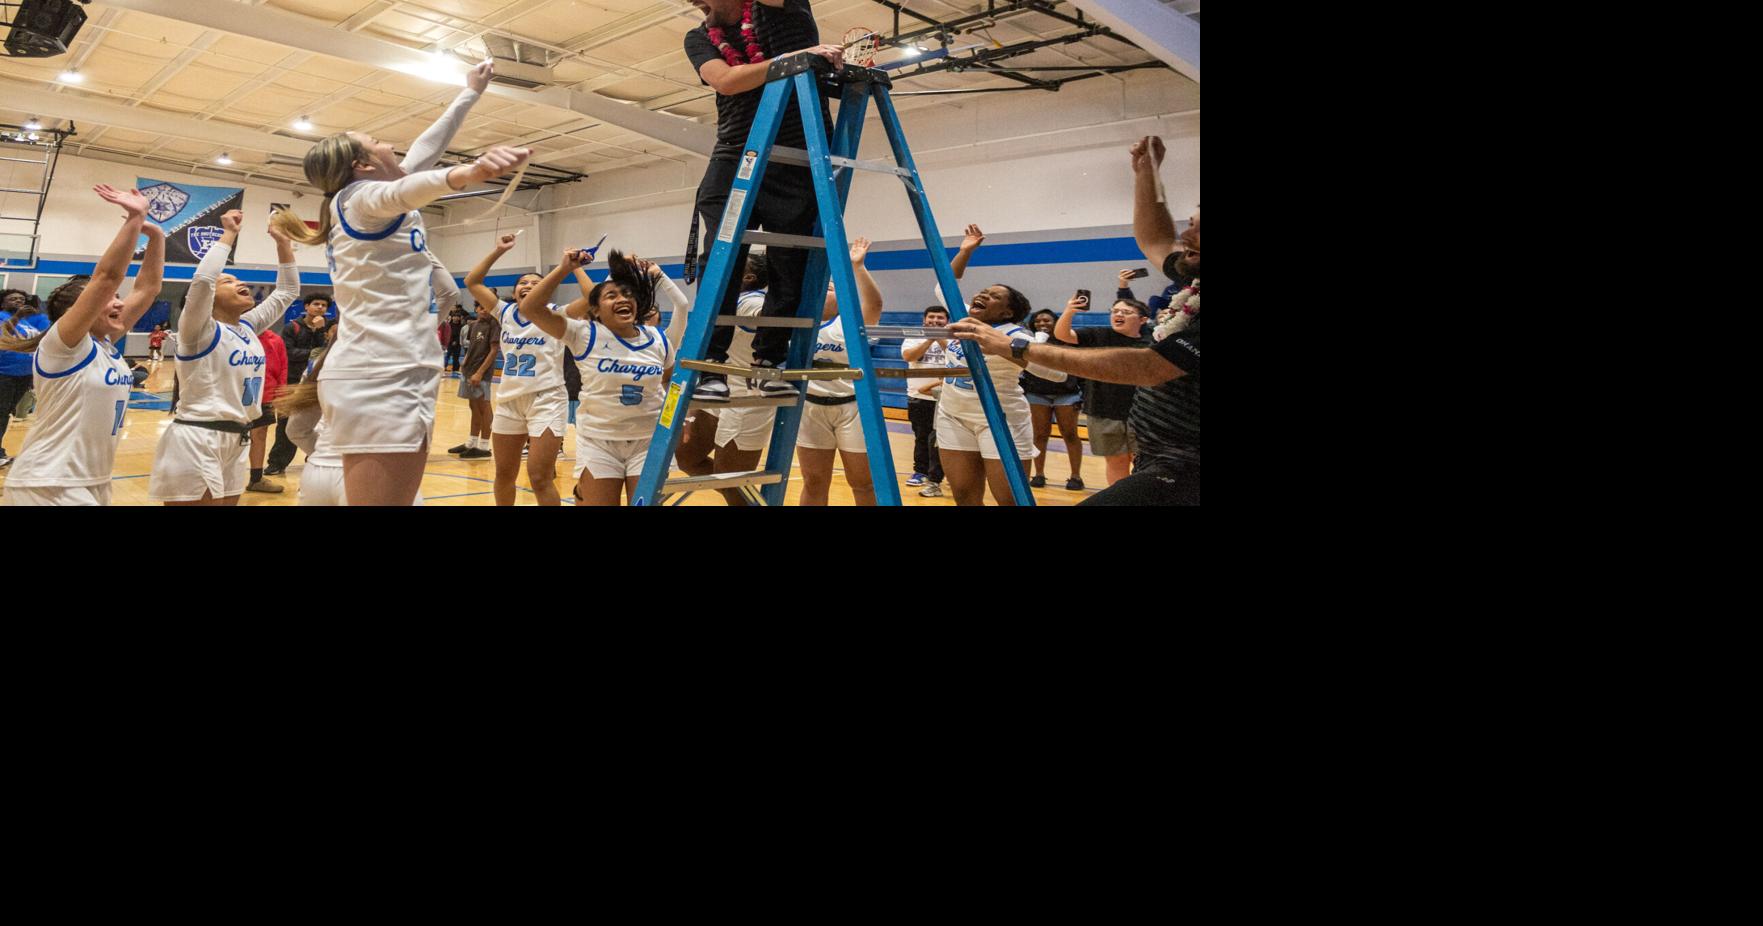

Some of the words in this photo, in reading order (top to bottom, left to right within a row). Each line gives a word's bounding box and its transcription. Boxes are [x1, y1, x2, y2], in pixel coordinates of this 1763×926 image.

[502, 331, 546, 350] Chargers
[504, 353, 536, 377] 22
[619, 384, 644, 406] 5
